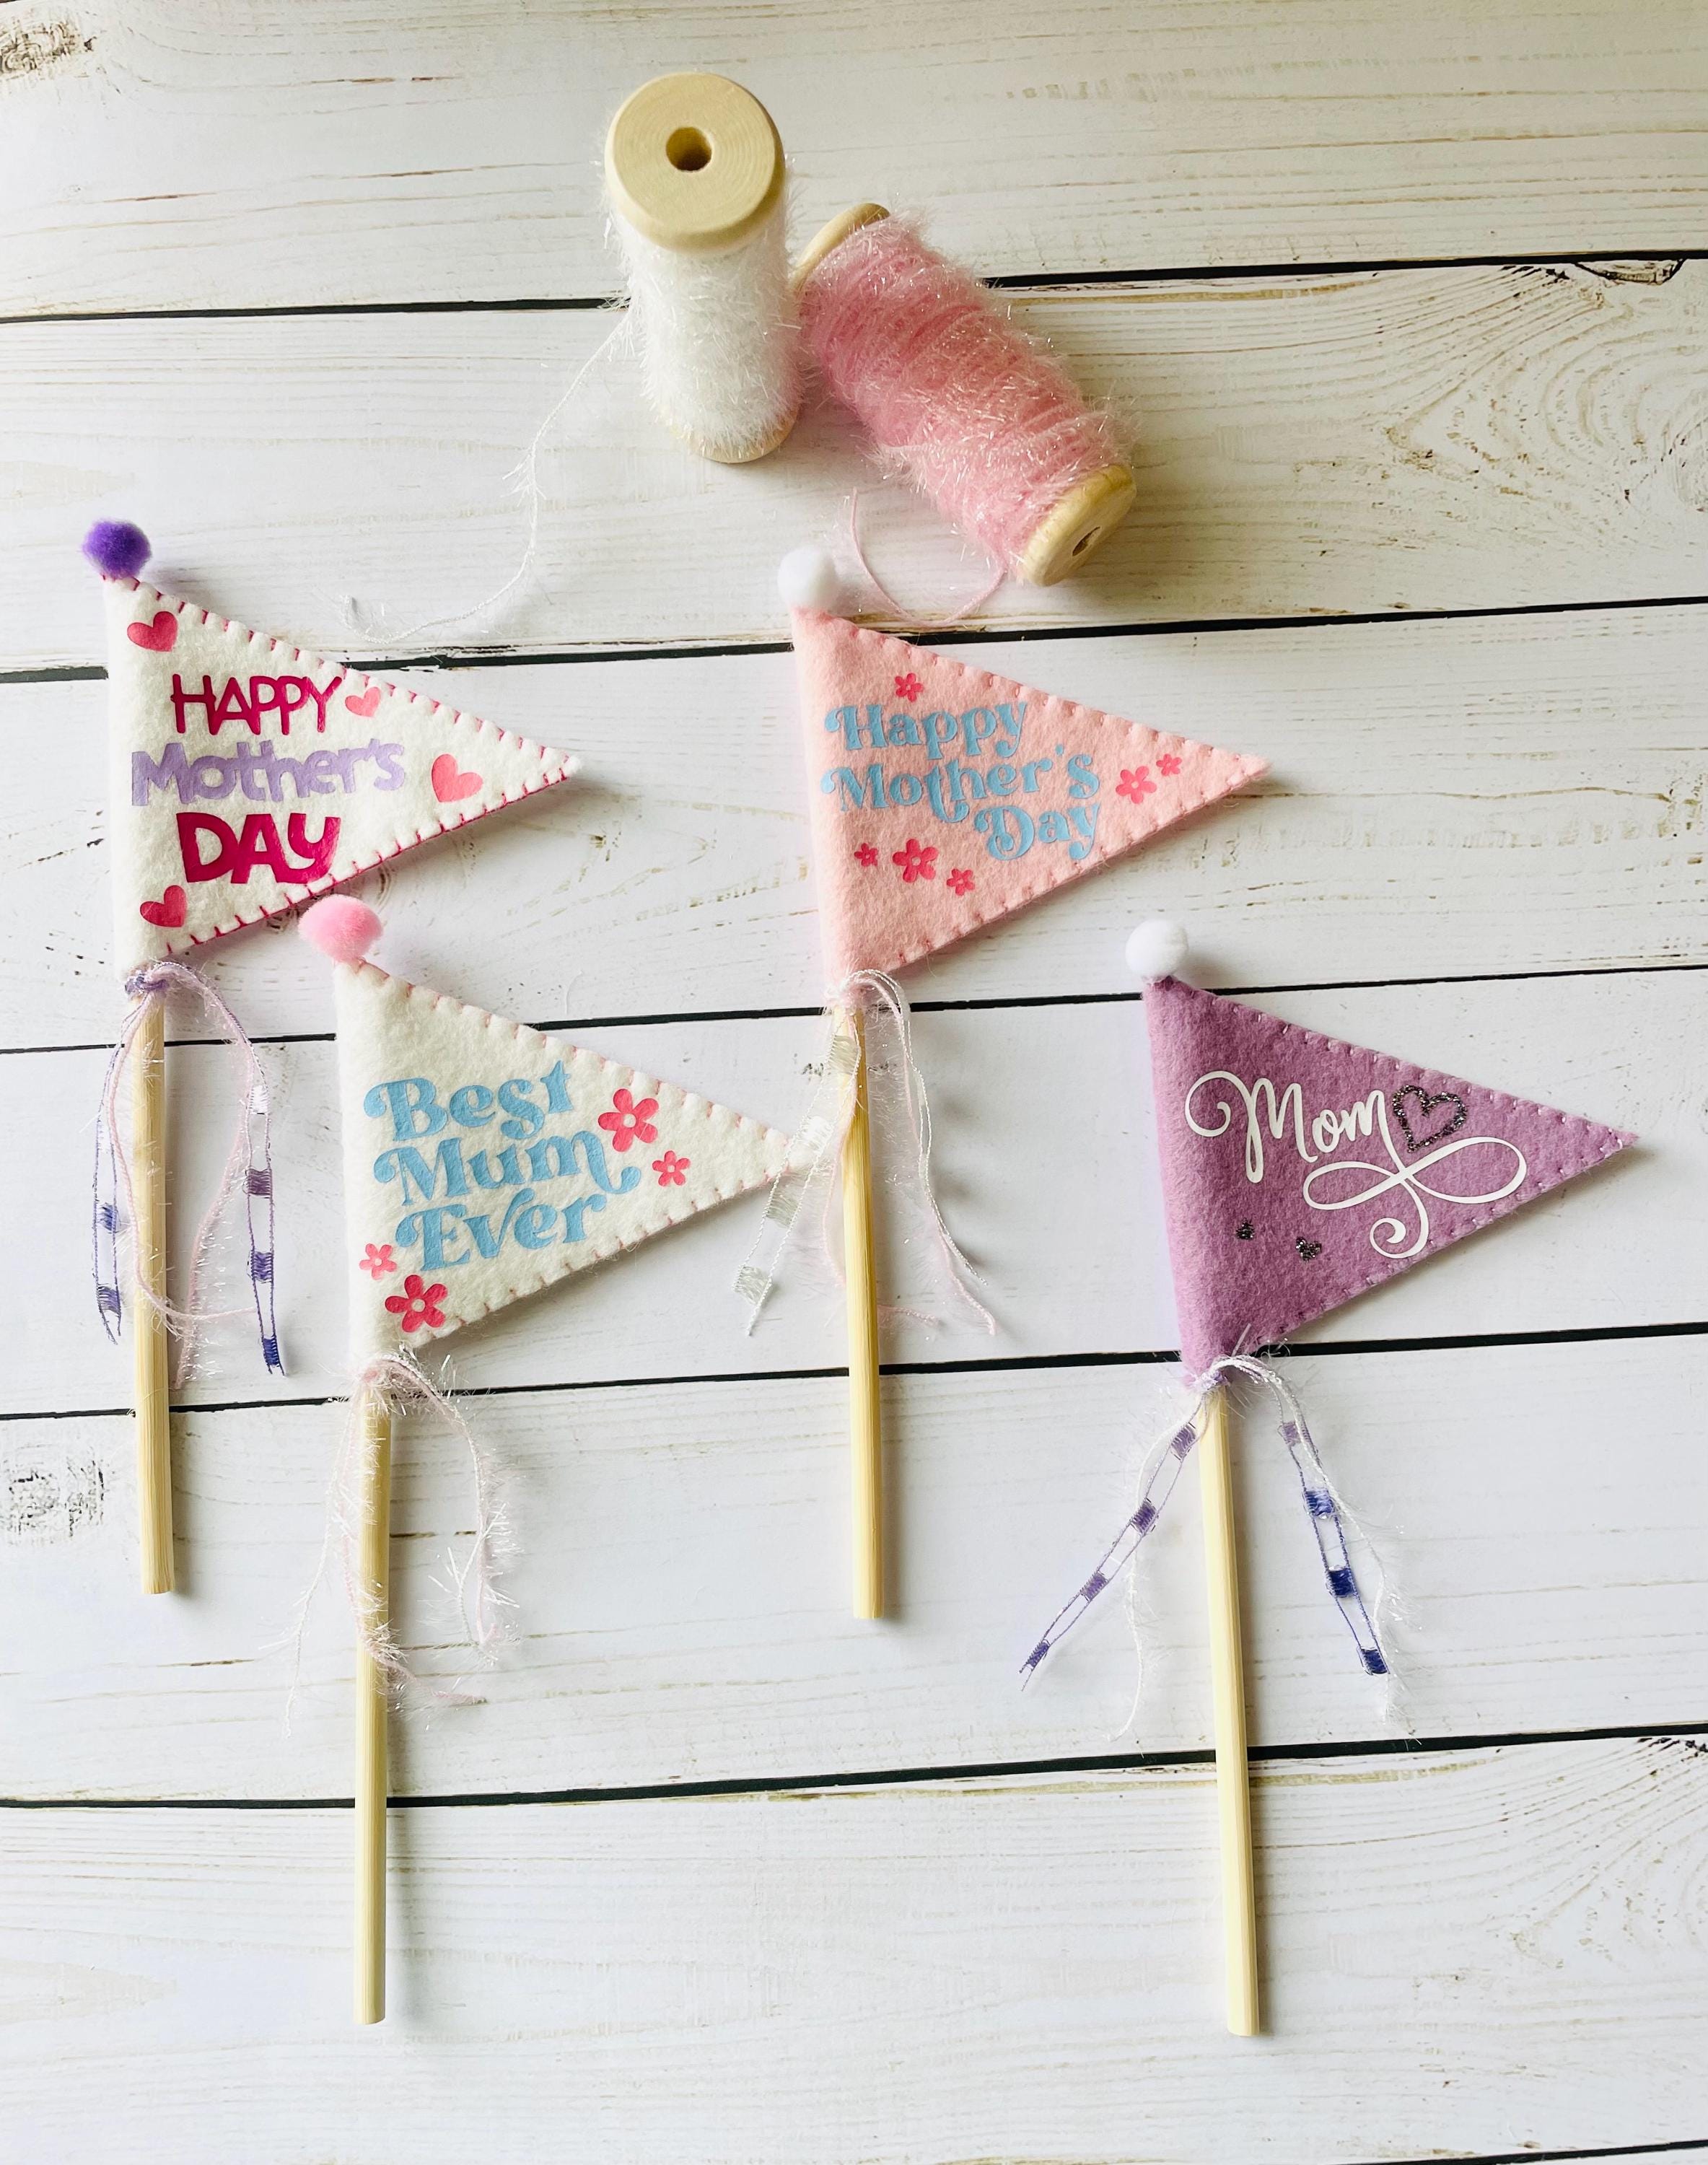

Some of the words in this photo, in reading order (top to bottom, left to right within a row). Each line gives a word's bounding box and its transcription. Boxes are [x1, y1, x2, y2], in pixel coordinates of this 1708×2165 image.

[170, 674, 342, 735] HAPPY
[824, 701, 1028, 760] Happy
[131, 738, 406, 806] Mother's
[820, 744, 1100, 823] Mother's
[176, 813, 341, 885] DAY
[974, 802, 1100, 860] Day
[363, 1060, 574, 1142] Best
[373, 1131, 641, 1206] Mum
[395, 1187, 608, 1272] Ever
